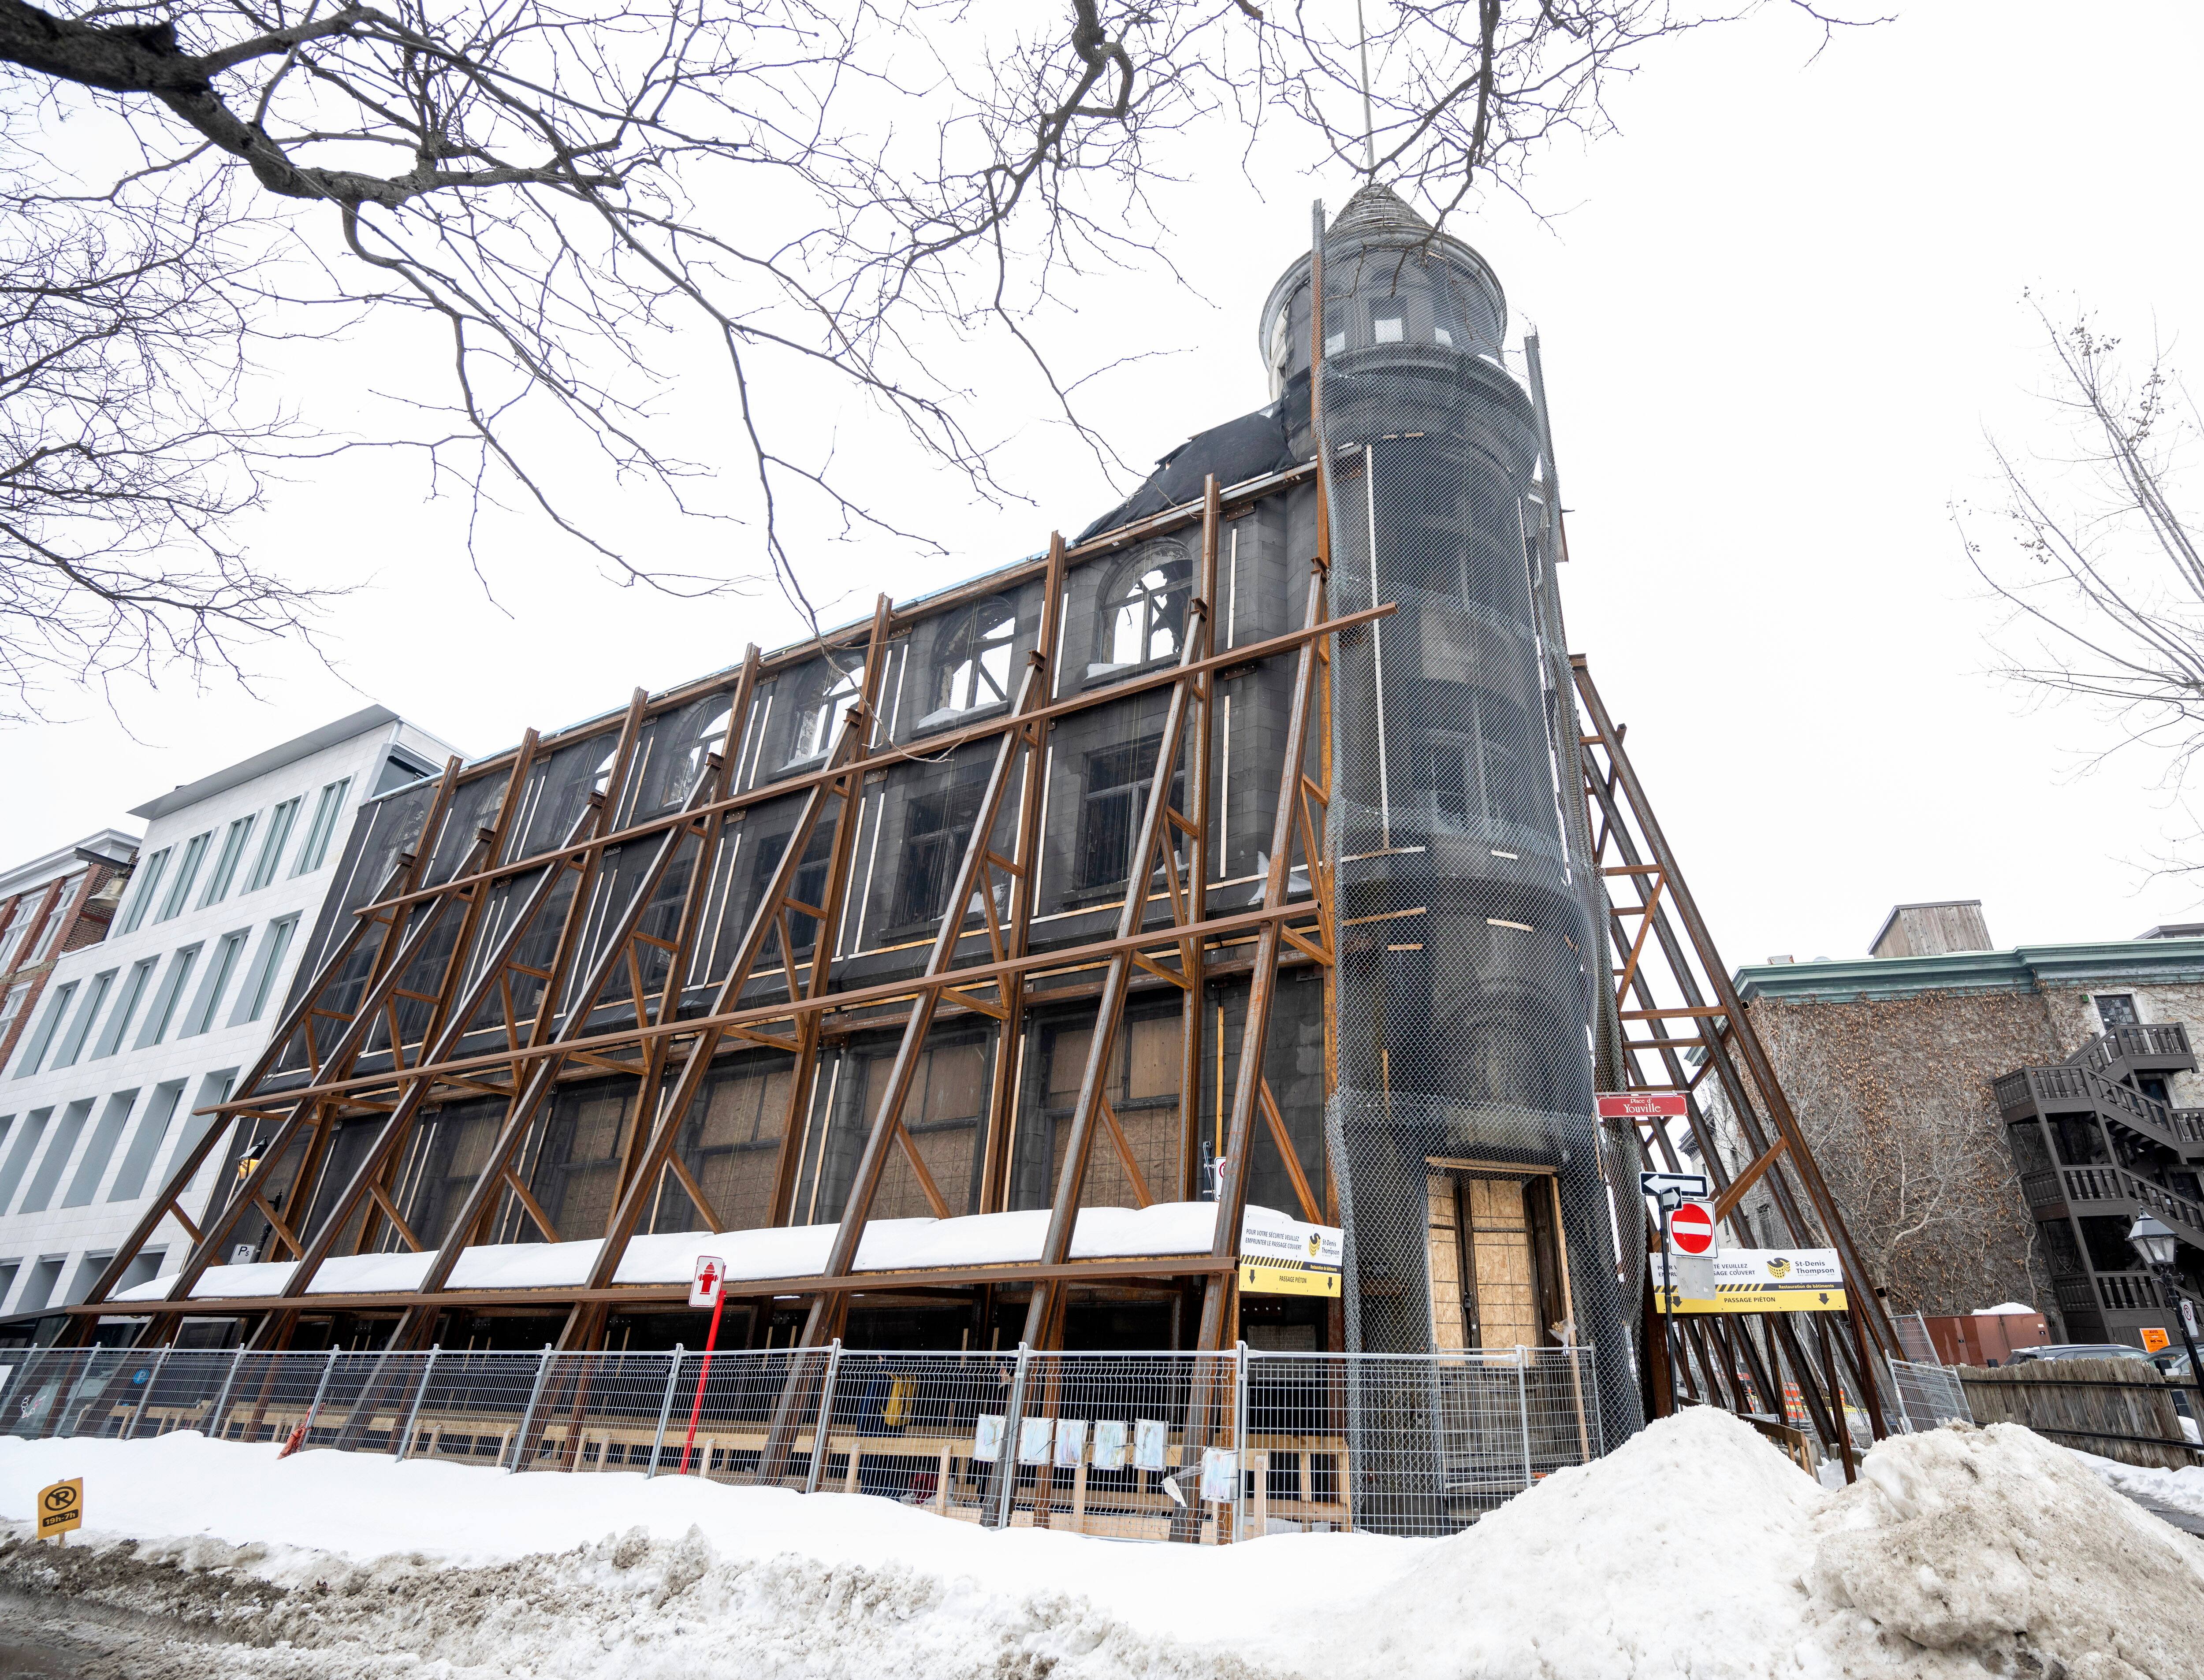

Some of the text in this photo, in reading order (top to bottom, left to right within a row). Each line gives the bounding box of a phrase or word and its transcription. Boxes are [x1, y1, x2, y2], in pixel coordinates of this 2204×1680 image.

[1623, 1103, 1661, 1113] Youville
[1322, 1247, 1340, 1256] Thompson
[45, 1512, 75, 1525] 19h-7h
